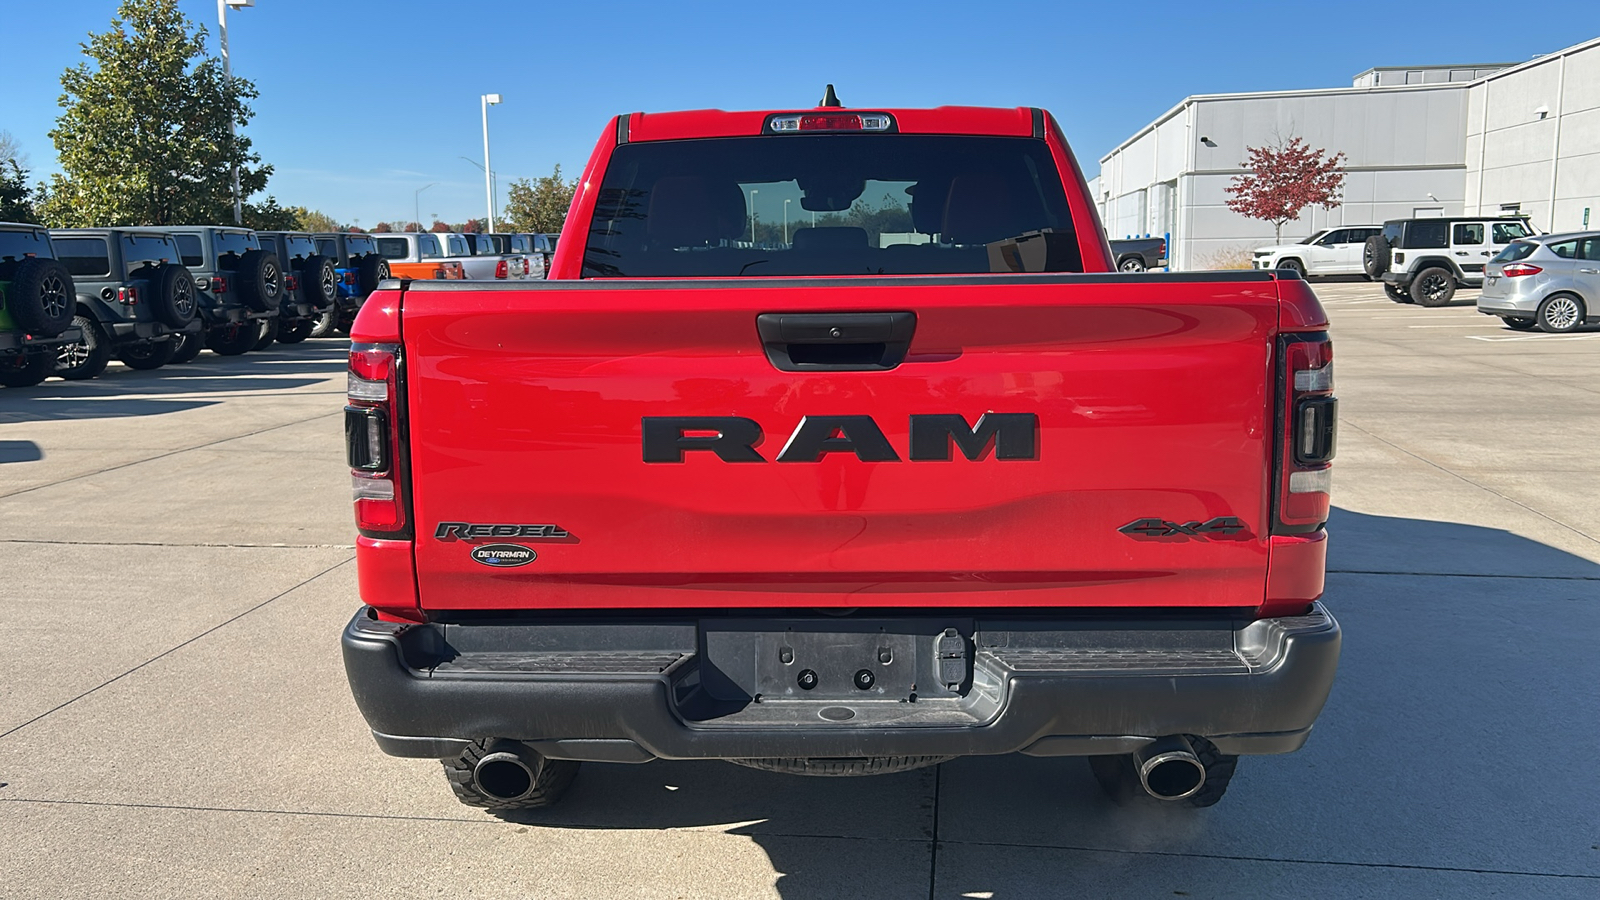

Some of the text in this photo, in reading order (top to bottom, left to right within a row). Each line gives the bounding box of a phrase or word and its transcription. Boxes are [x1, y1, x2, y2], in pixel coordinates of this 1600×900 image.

[641, 412, 1037, 463] RAM
[434, 521, 569, 539] REBEL
[477, 550, 530, 558] DEYARMAN
